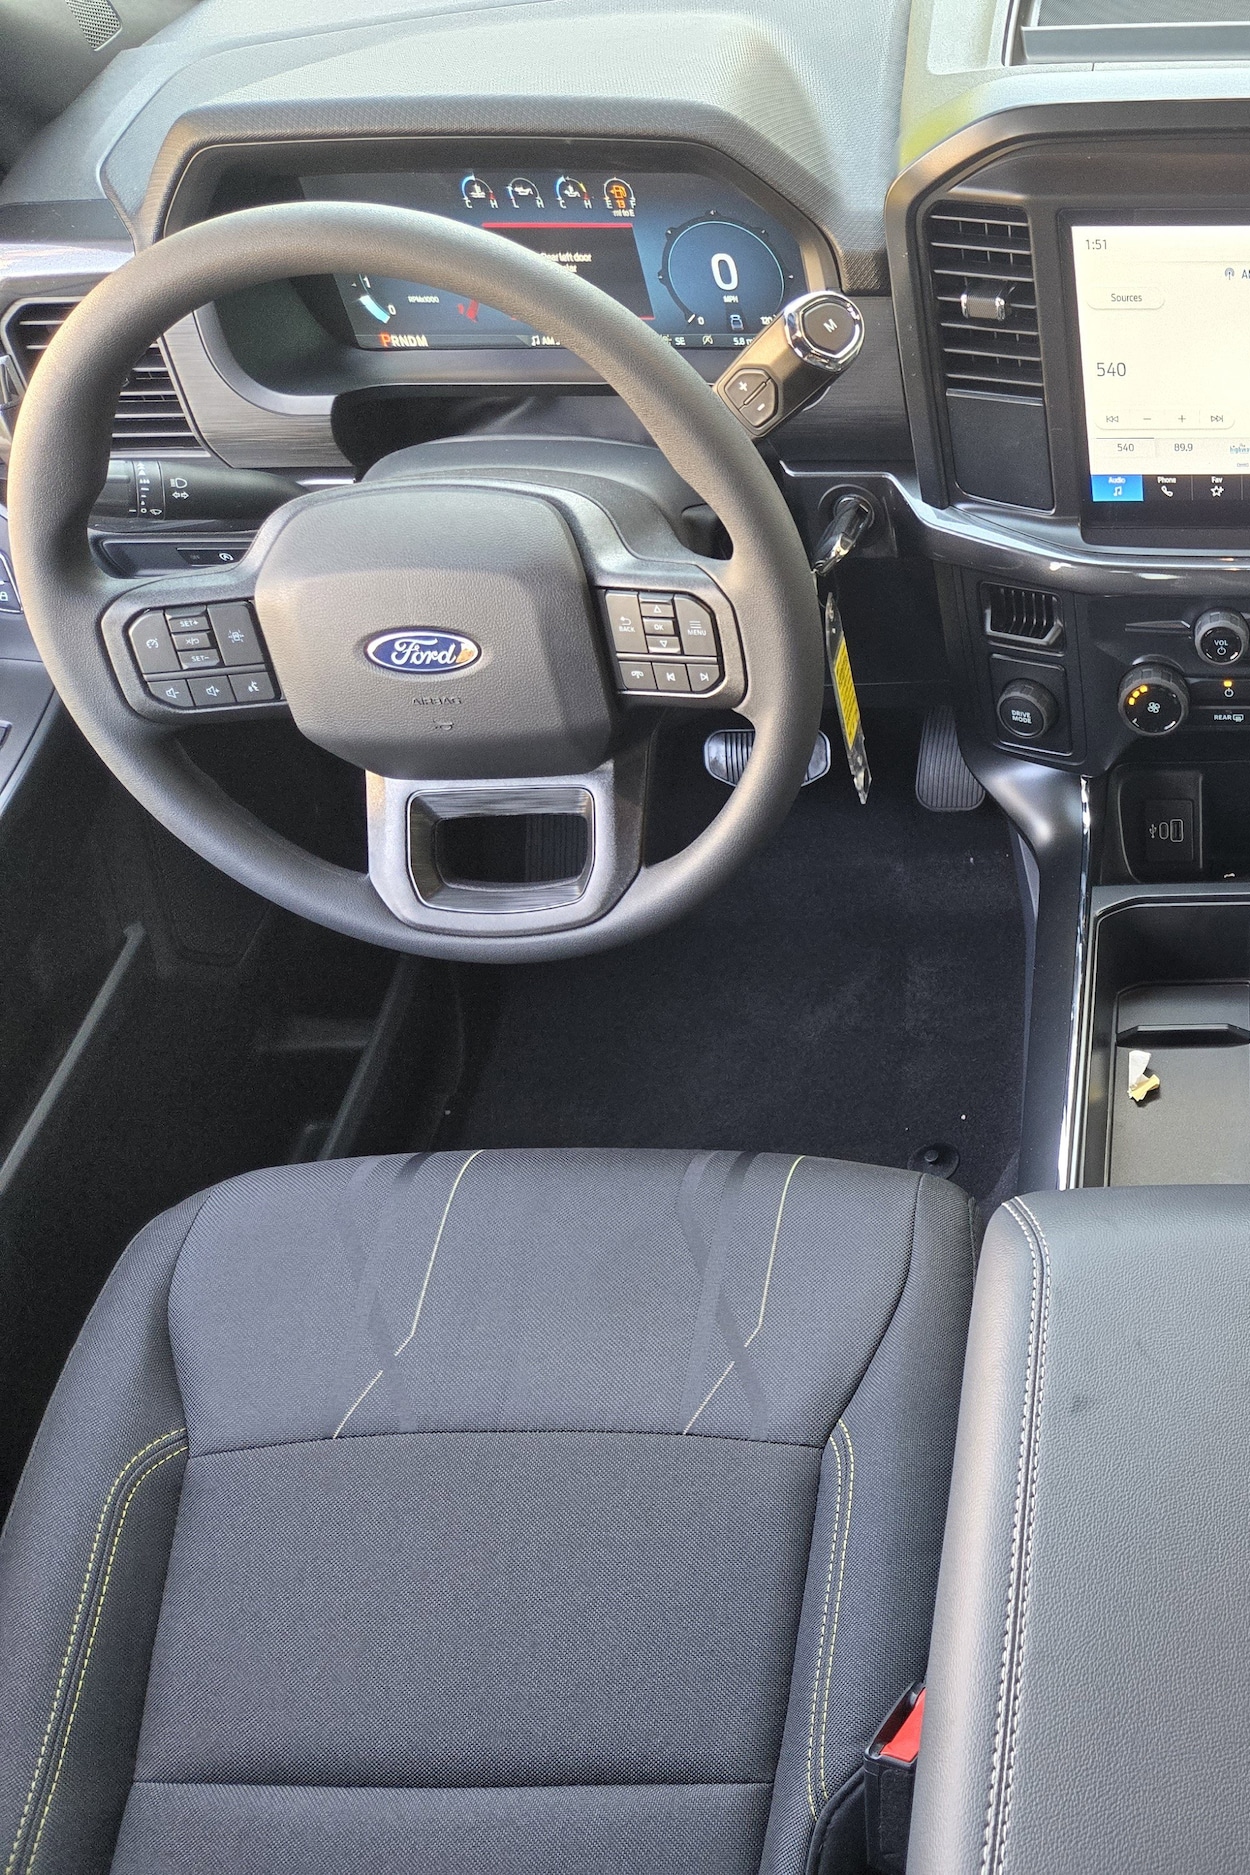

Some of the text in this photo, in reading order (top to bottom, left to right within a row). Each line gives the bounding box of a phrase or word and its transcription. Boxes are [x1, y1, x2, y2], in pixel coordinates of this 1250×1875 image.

[466, 200, 498, 208] C H
[513, 200, 545, 208] L H
[560, 200, 592, 208] C H
[606, 200, 613, 208] E
[631, 200, 637, 208] F
[1086, 239, 1107, 250] 1:51
[559, 252, 574, 262] left
[574, 252, 592, 262] door
[711, 253, 738, 291] 0
[363, 276, 371, 288] 1
[723, 295, 738, 303] MPH
[1111, 293, 1142, 302] Sources
[388, 304, 396, 315] 0
[698, 317, 705, 325] 0
[823, 319, 838, 333] M
[675, 337, 686, 346] SE
[733, 337, 746, 346] 5.8
[1096, 362, 1127, 377] 540
[1117, 443, 1135, 452] 540
[1174, 443, 1194, 452] 89.9
[1108, 476, 1126, 484] Audio
[1157, 476, 1177, 484] Phone
[1211, 476, 1223, 484] Fav
[687, 629, 707, 637] MENU
[391, 637, 457, 665] Ford
[1011, 709, 1031, 719] DRIVE
[1012, 715, 1032, 724] MODE
